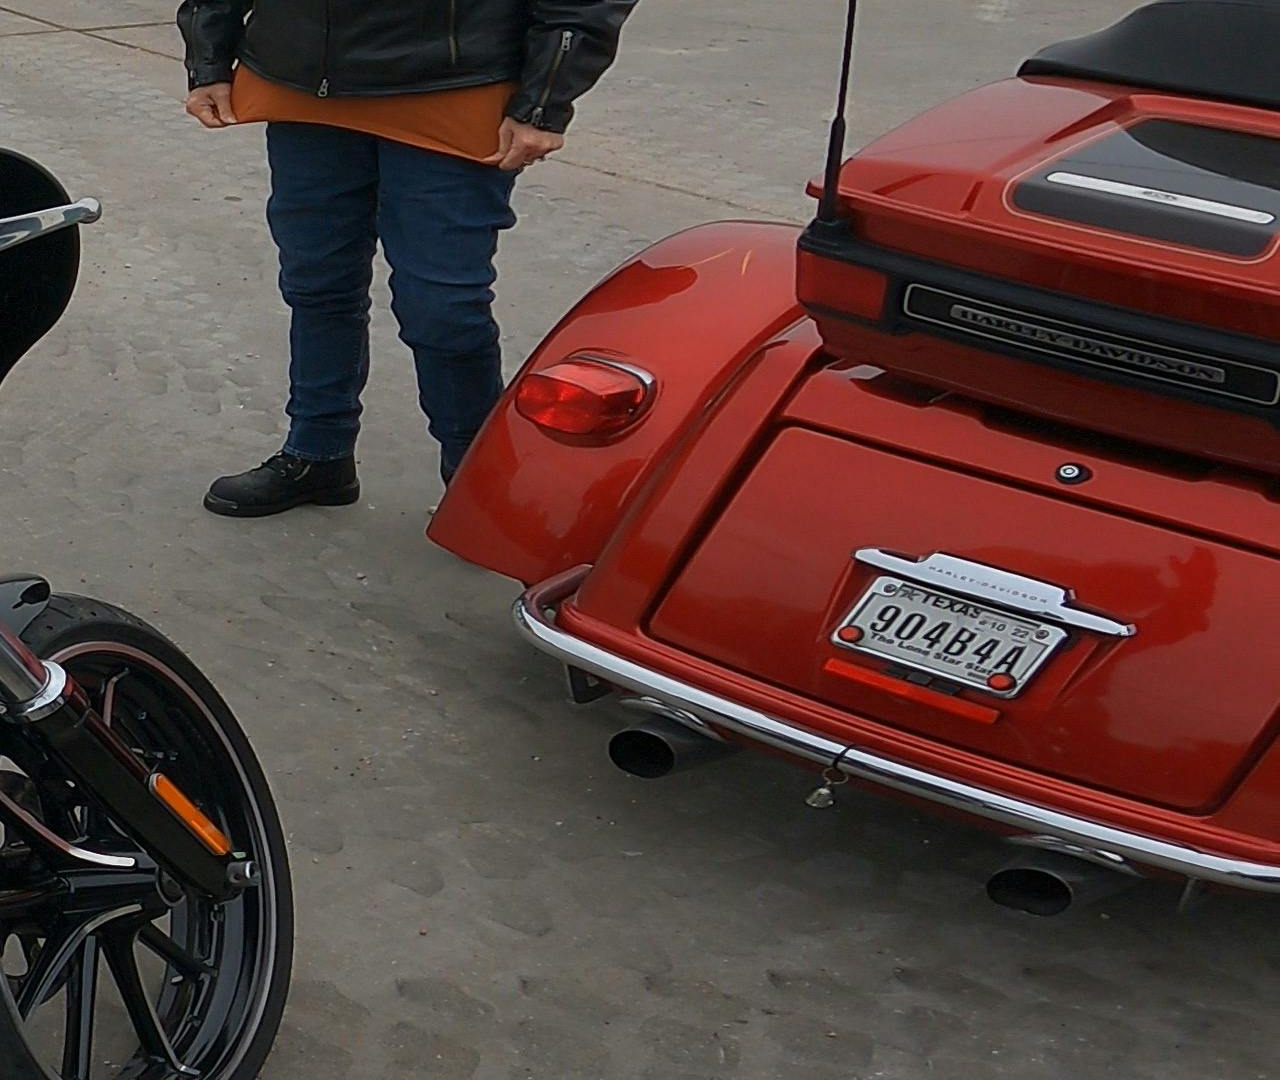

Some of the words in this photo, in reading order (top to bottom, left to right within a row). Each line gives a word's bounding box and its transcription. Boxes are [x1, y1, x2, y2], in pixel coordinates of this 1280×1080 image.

[928, 565, 1049, 605] HARLEY-DAVIDSON
[921, 592, 982, 619] TEXAS
[870, 604, 1027, 673] 904B4A
[871, 632, 895, 645] The
[898, 641, 931, 657] Lone
[933, 650, 962, 666] Star
